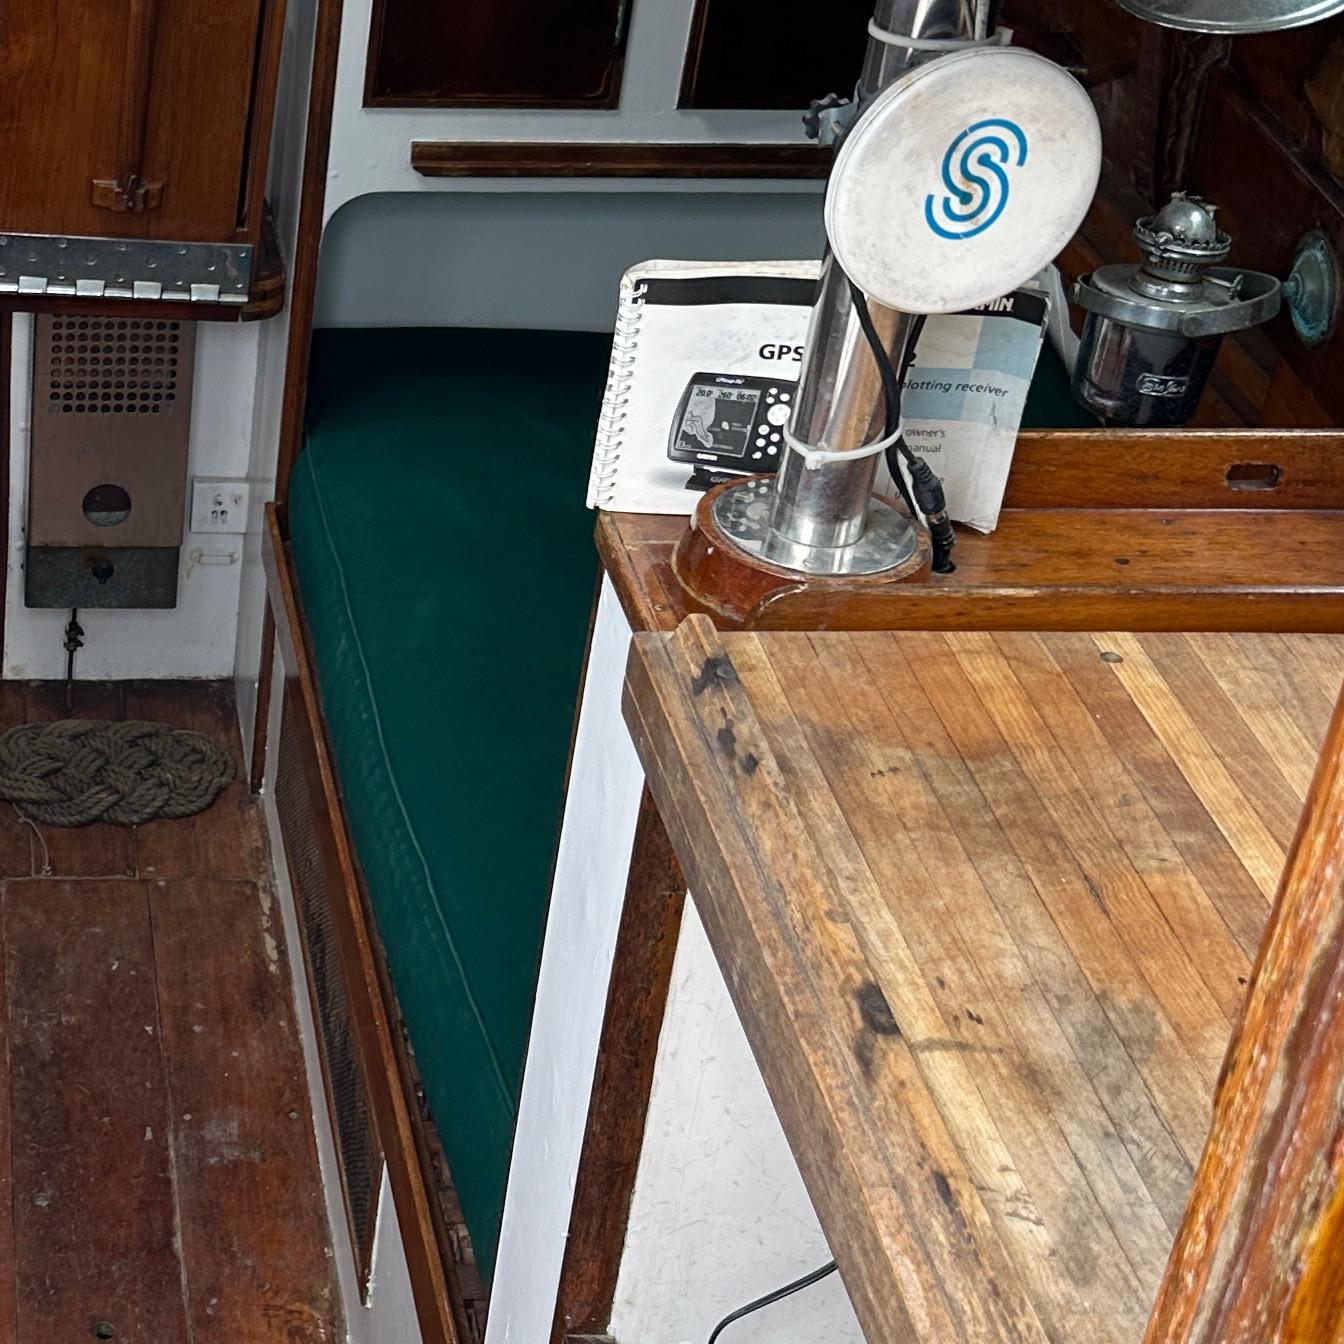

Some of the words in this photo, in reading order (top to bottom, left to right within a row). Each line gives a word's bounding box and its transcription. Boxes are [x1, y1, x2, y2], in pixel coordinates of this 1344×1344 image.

[759, 344, 805, 361] GPS
[955, 383, 1009, 398] receiver
[905, 428, 946, 438] owner's
